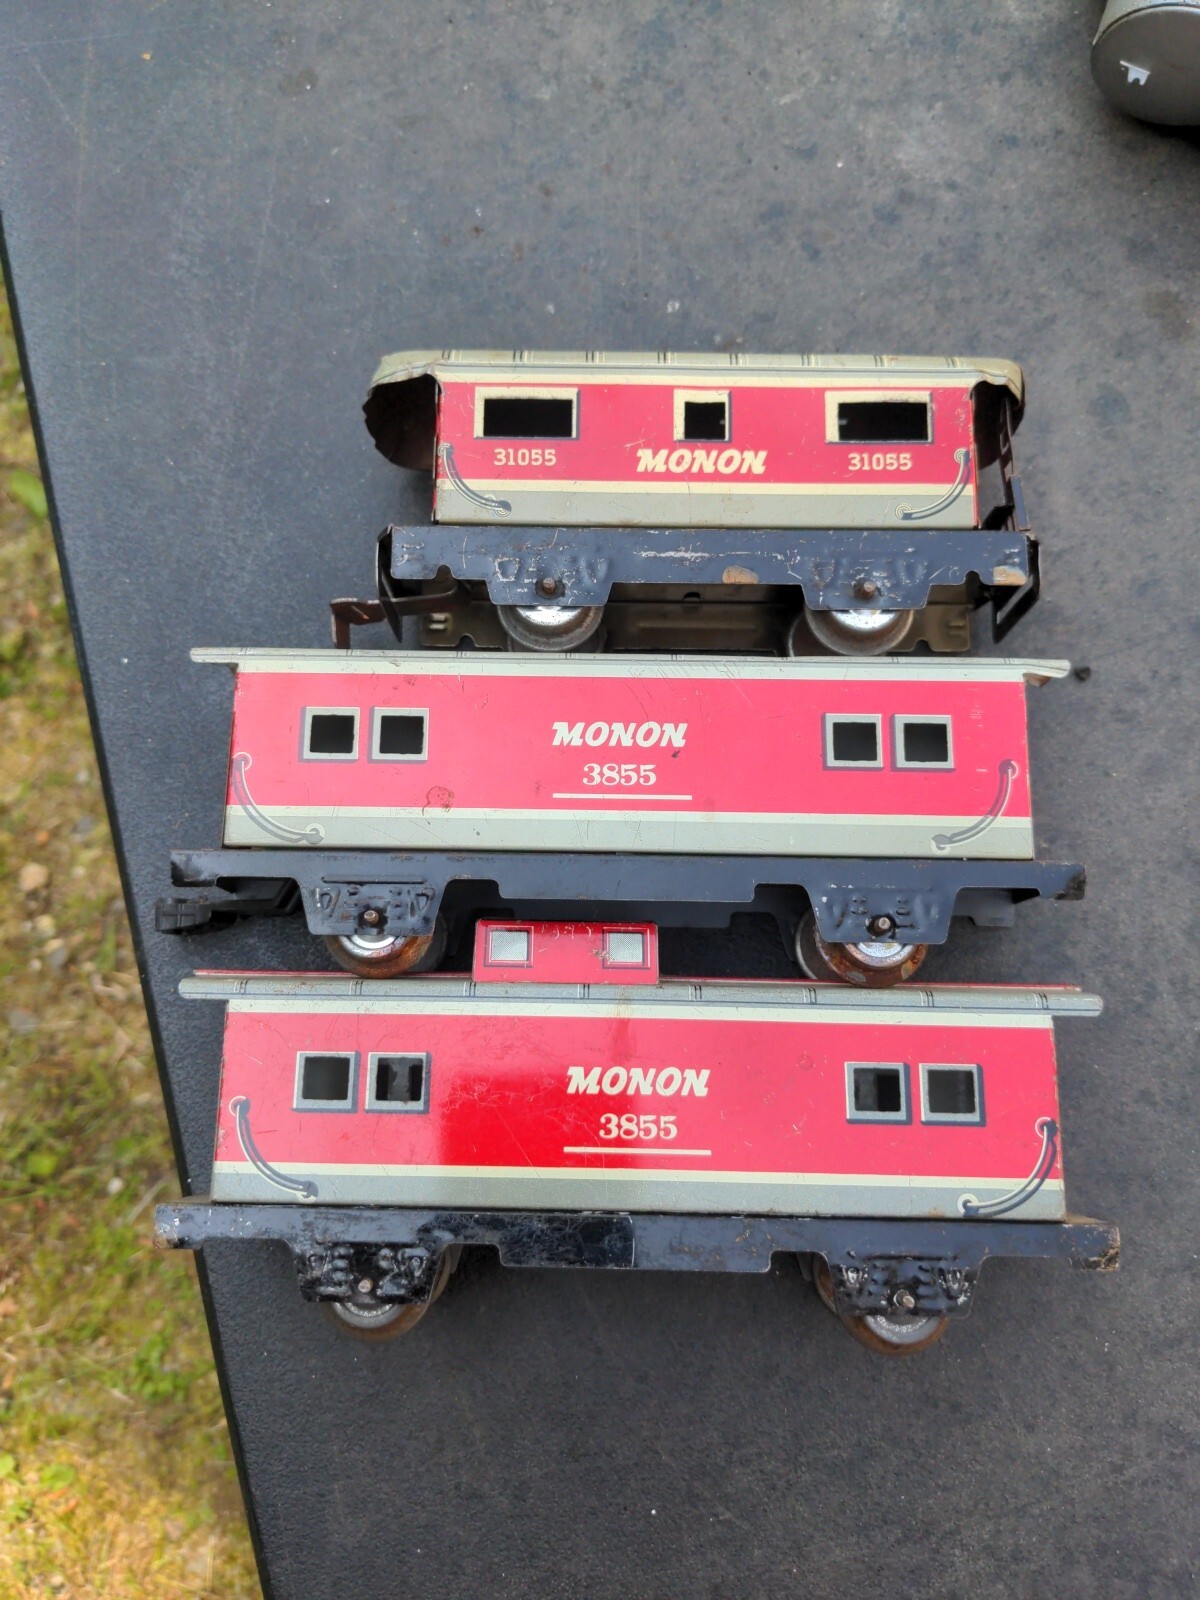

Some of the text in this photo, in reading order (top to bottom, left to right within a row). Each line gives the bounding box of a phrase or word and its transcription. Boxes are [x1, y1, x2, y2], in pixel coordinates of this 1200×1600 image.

[493, 447, 557, 467] 31055
[636, 448, 768, 475] MONON
[848, 452, 913, 471] 31055
[551, 720, 689, 748] MONON
[582, 762, 657, 787] 3855
[566, 1065, 711, 1098] MONON
[599, 1113, 678, 1140] 3855
